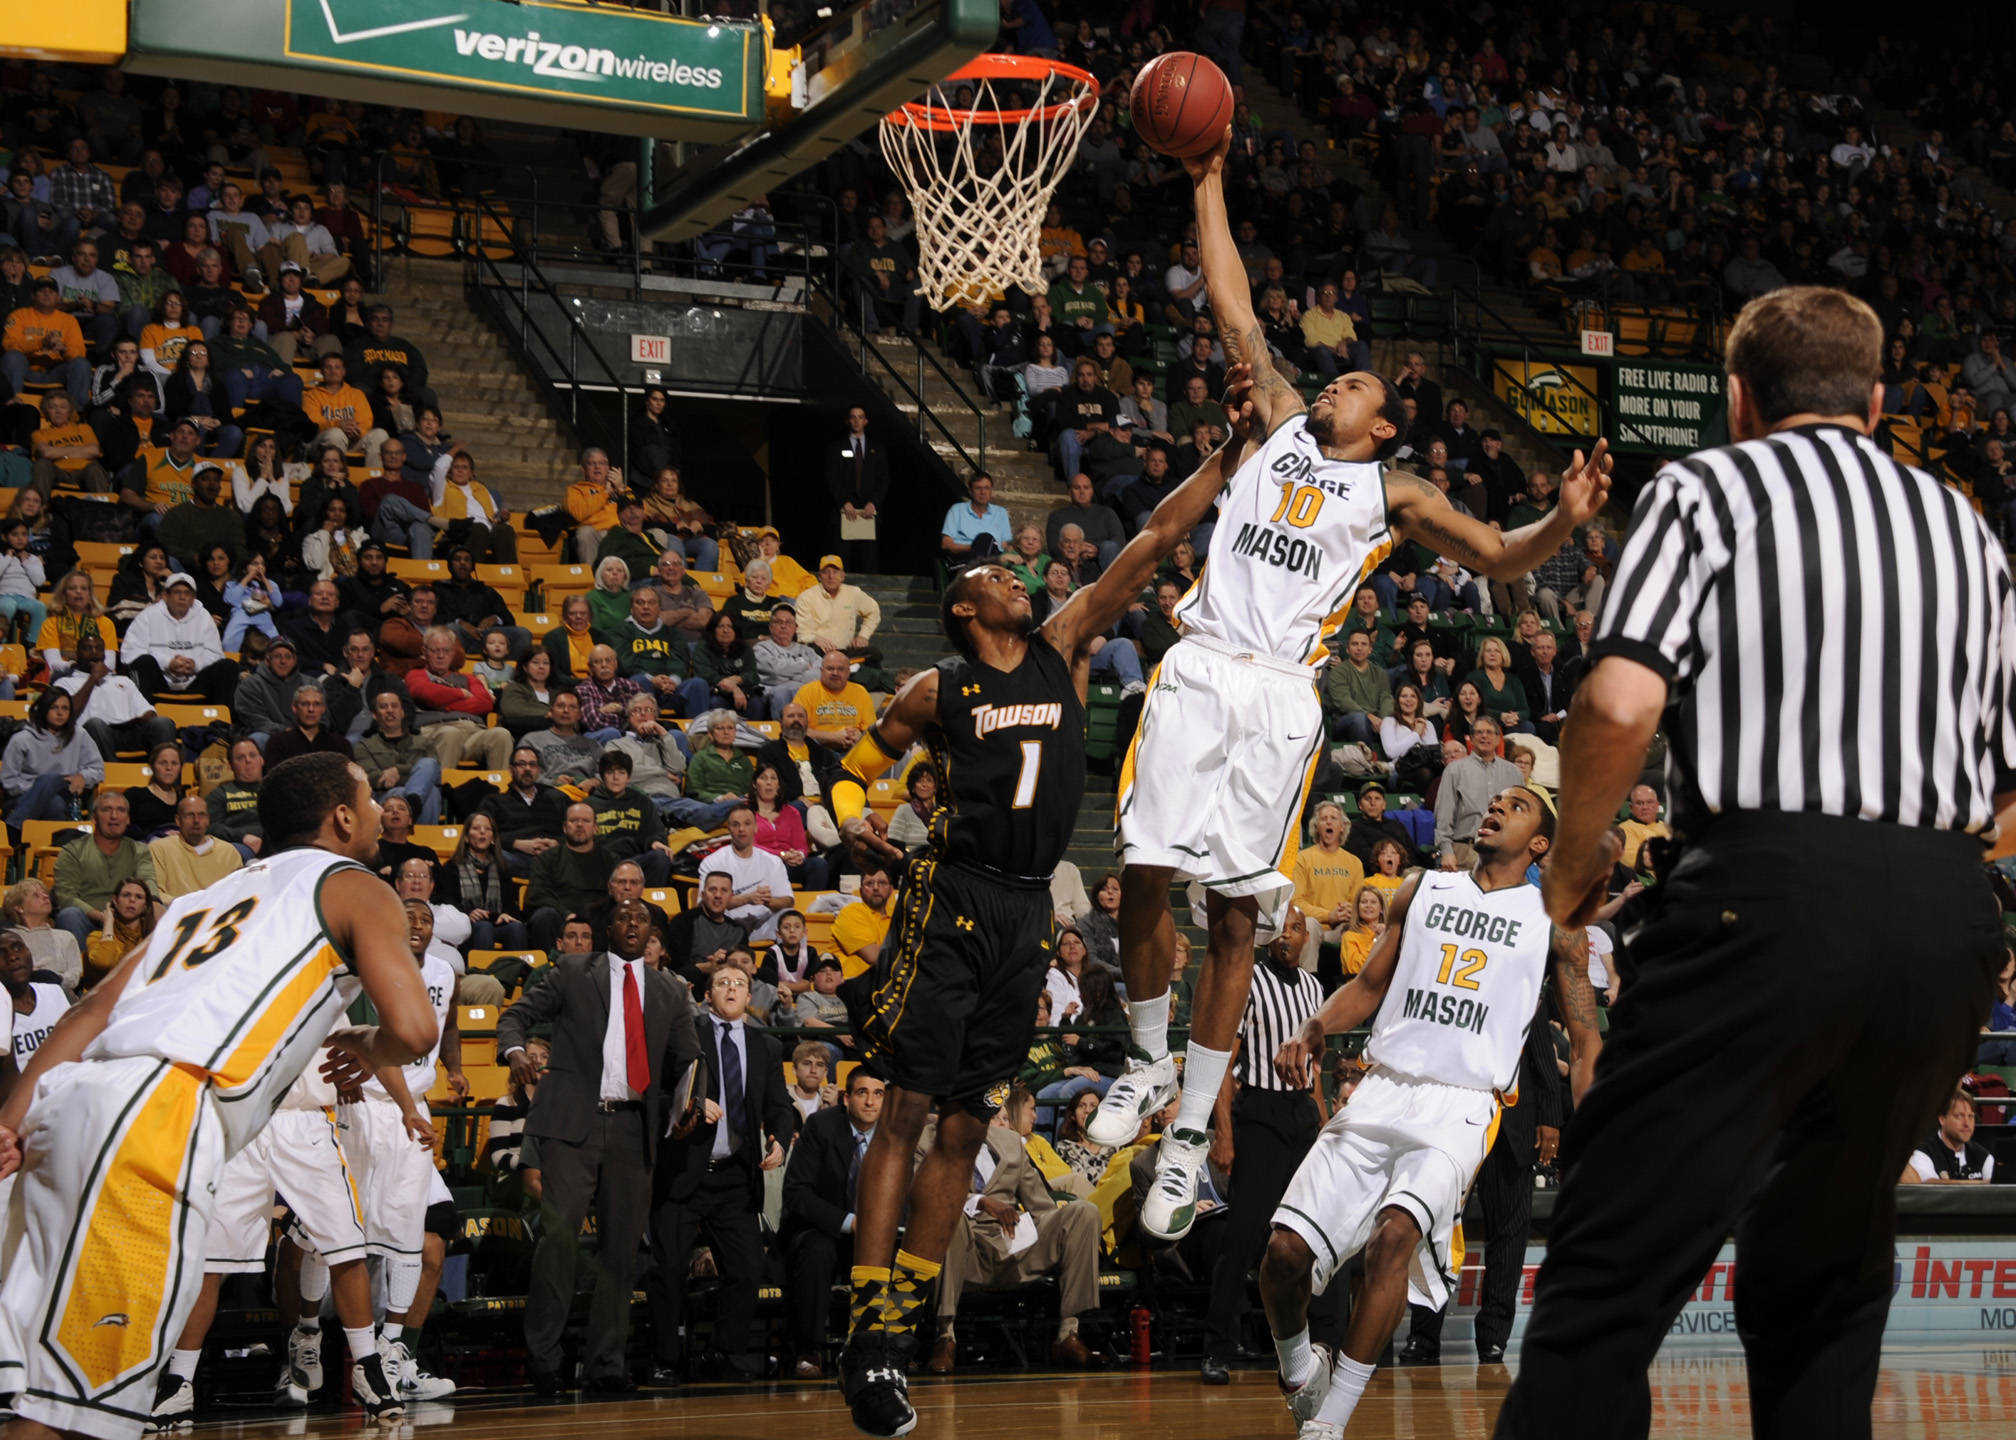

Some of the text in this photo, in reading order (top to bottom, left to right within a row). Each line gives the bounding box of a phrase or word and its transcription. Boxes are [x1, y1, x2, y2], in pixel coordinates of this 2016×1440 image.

[453, 28, 722, 89] verizon wireless
[639, 339, 665, 359] EXIT
[1588, 334, 1609, 352] EXIT
[1619, 367, 1720, 394] FREE LIVE RADIO &
[1619, 395, 1701, 420] MORE ON YOUR
[1270, 481, 1326, 529] 10
[1231, 523, 1324, 581] MASON
[971, 702, 1062, 740] TOWSON
[1011, 740, 1042, 810] 1
[1313, 866, 1350, 877] MASON
[144, 895, 261, 988] 13
[1424, 902, 1522, 949] GEORGE
[1436, 943, 1488, 991] 12
[1403, 988, 1489, 1035] MASON
[463, 1217, 523, 1241] ASON
